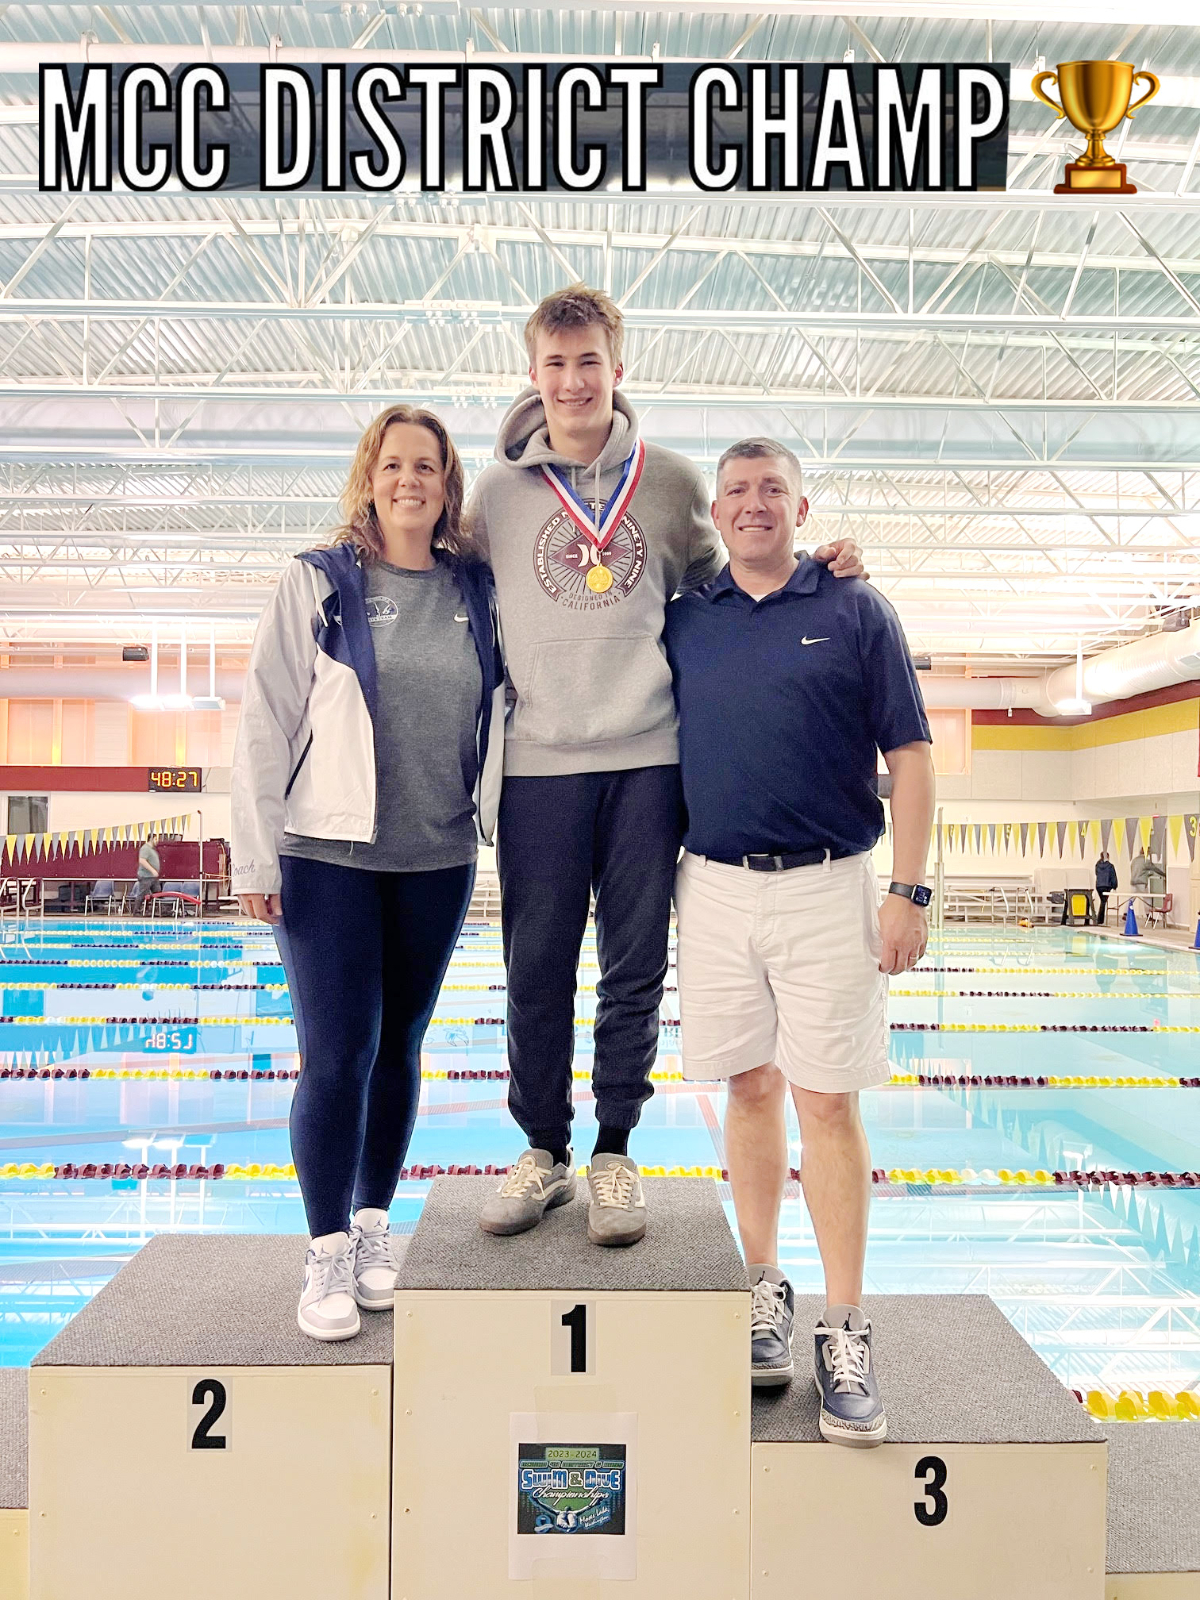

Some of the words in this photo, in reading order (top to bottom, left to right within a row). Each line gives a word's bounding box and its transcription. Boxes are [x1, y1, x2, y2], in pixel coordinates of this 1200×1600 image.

[621, 515, 644, 557] NINETY
[537, 517, 560, 594] ESTABLISHED
[624, 560, 643, 588] NINE
[562, 595, 621, 611] CALIFORNIA
[568, 592, 603, 601] DESIGNED
[151, 771, 198, 788] 48:27
[1081, 822, 1087, 837] 4
[1189, 816, 1197, 837] 3
[561, 1304, 587, 1373] 1
[191, 1379, 227, 1450] 2
[547, 1450, 598, 1459] 2023-2024
[569, 1472, 583, 1486] &
[532, 1485, 610, 1506] Championships
[913, 1456, 949, 1527] 3
